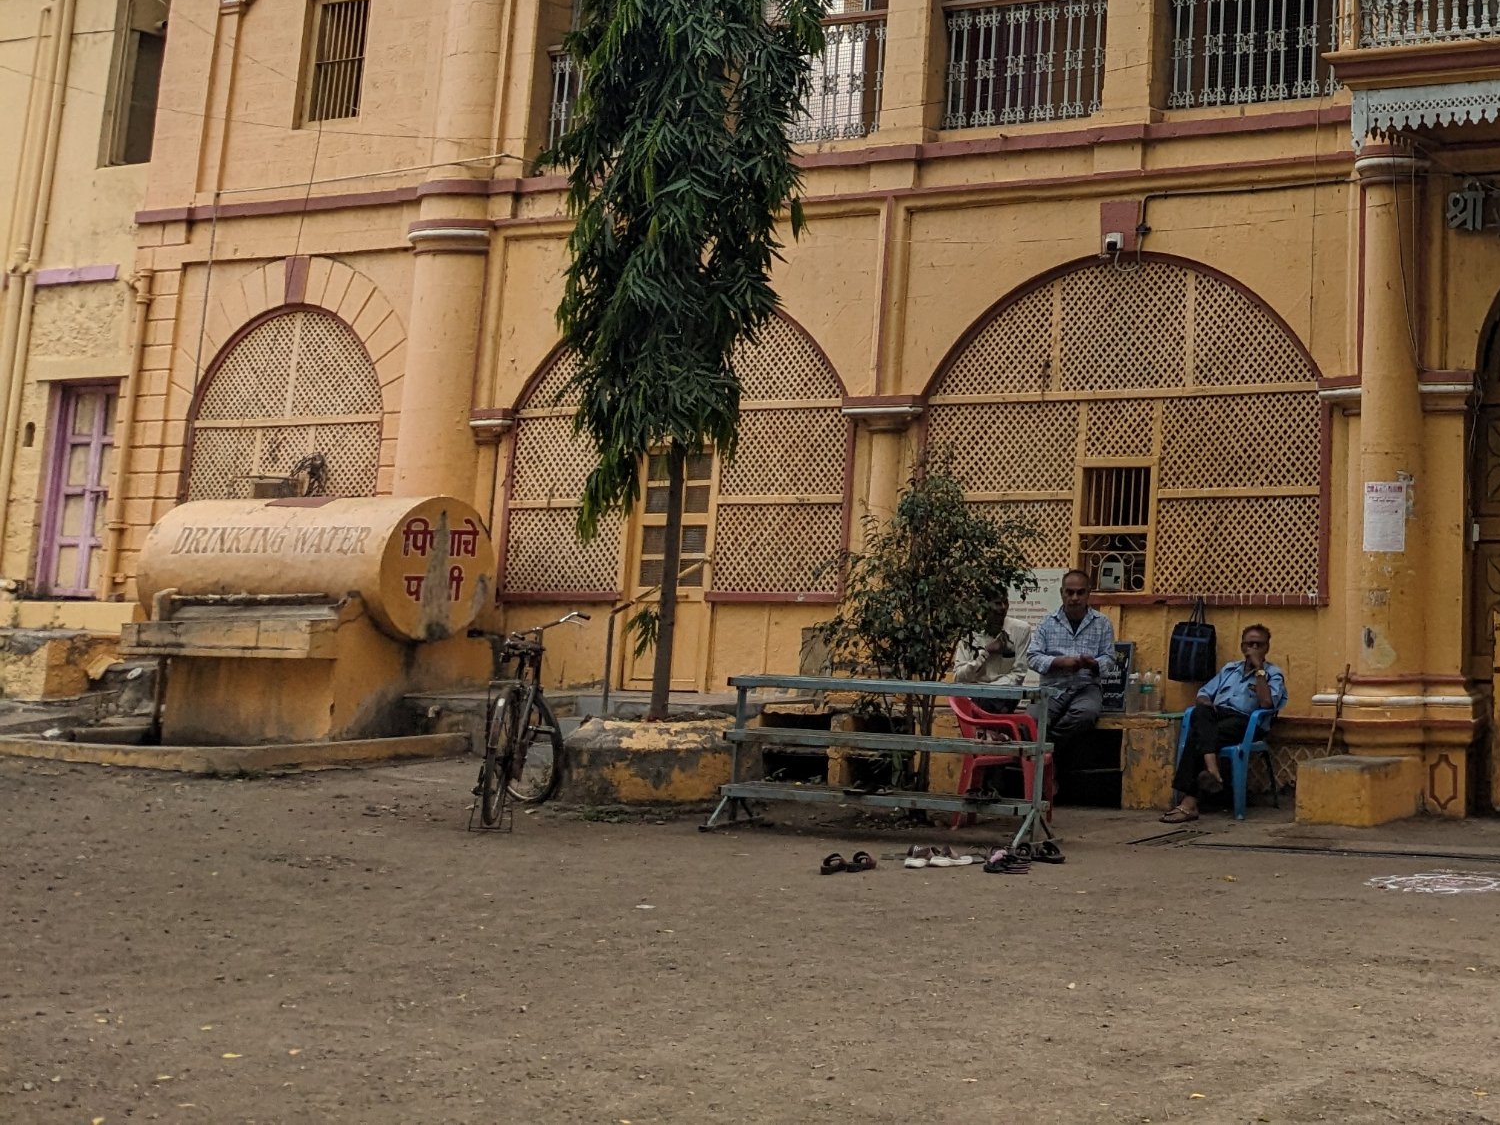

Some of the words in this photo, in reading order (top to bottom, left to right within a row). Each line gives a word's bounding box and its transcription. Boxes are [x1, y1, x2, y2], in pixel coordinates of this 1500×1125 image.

[1446, 177, 1486, 232] श्री
[170, 526, 289, 555] DRINKING
[292, 525, 372, 555] WATER
